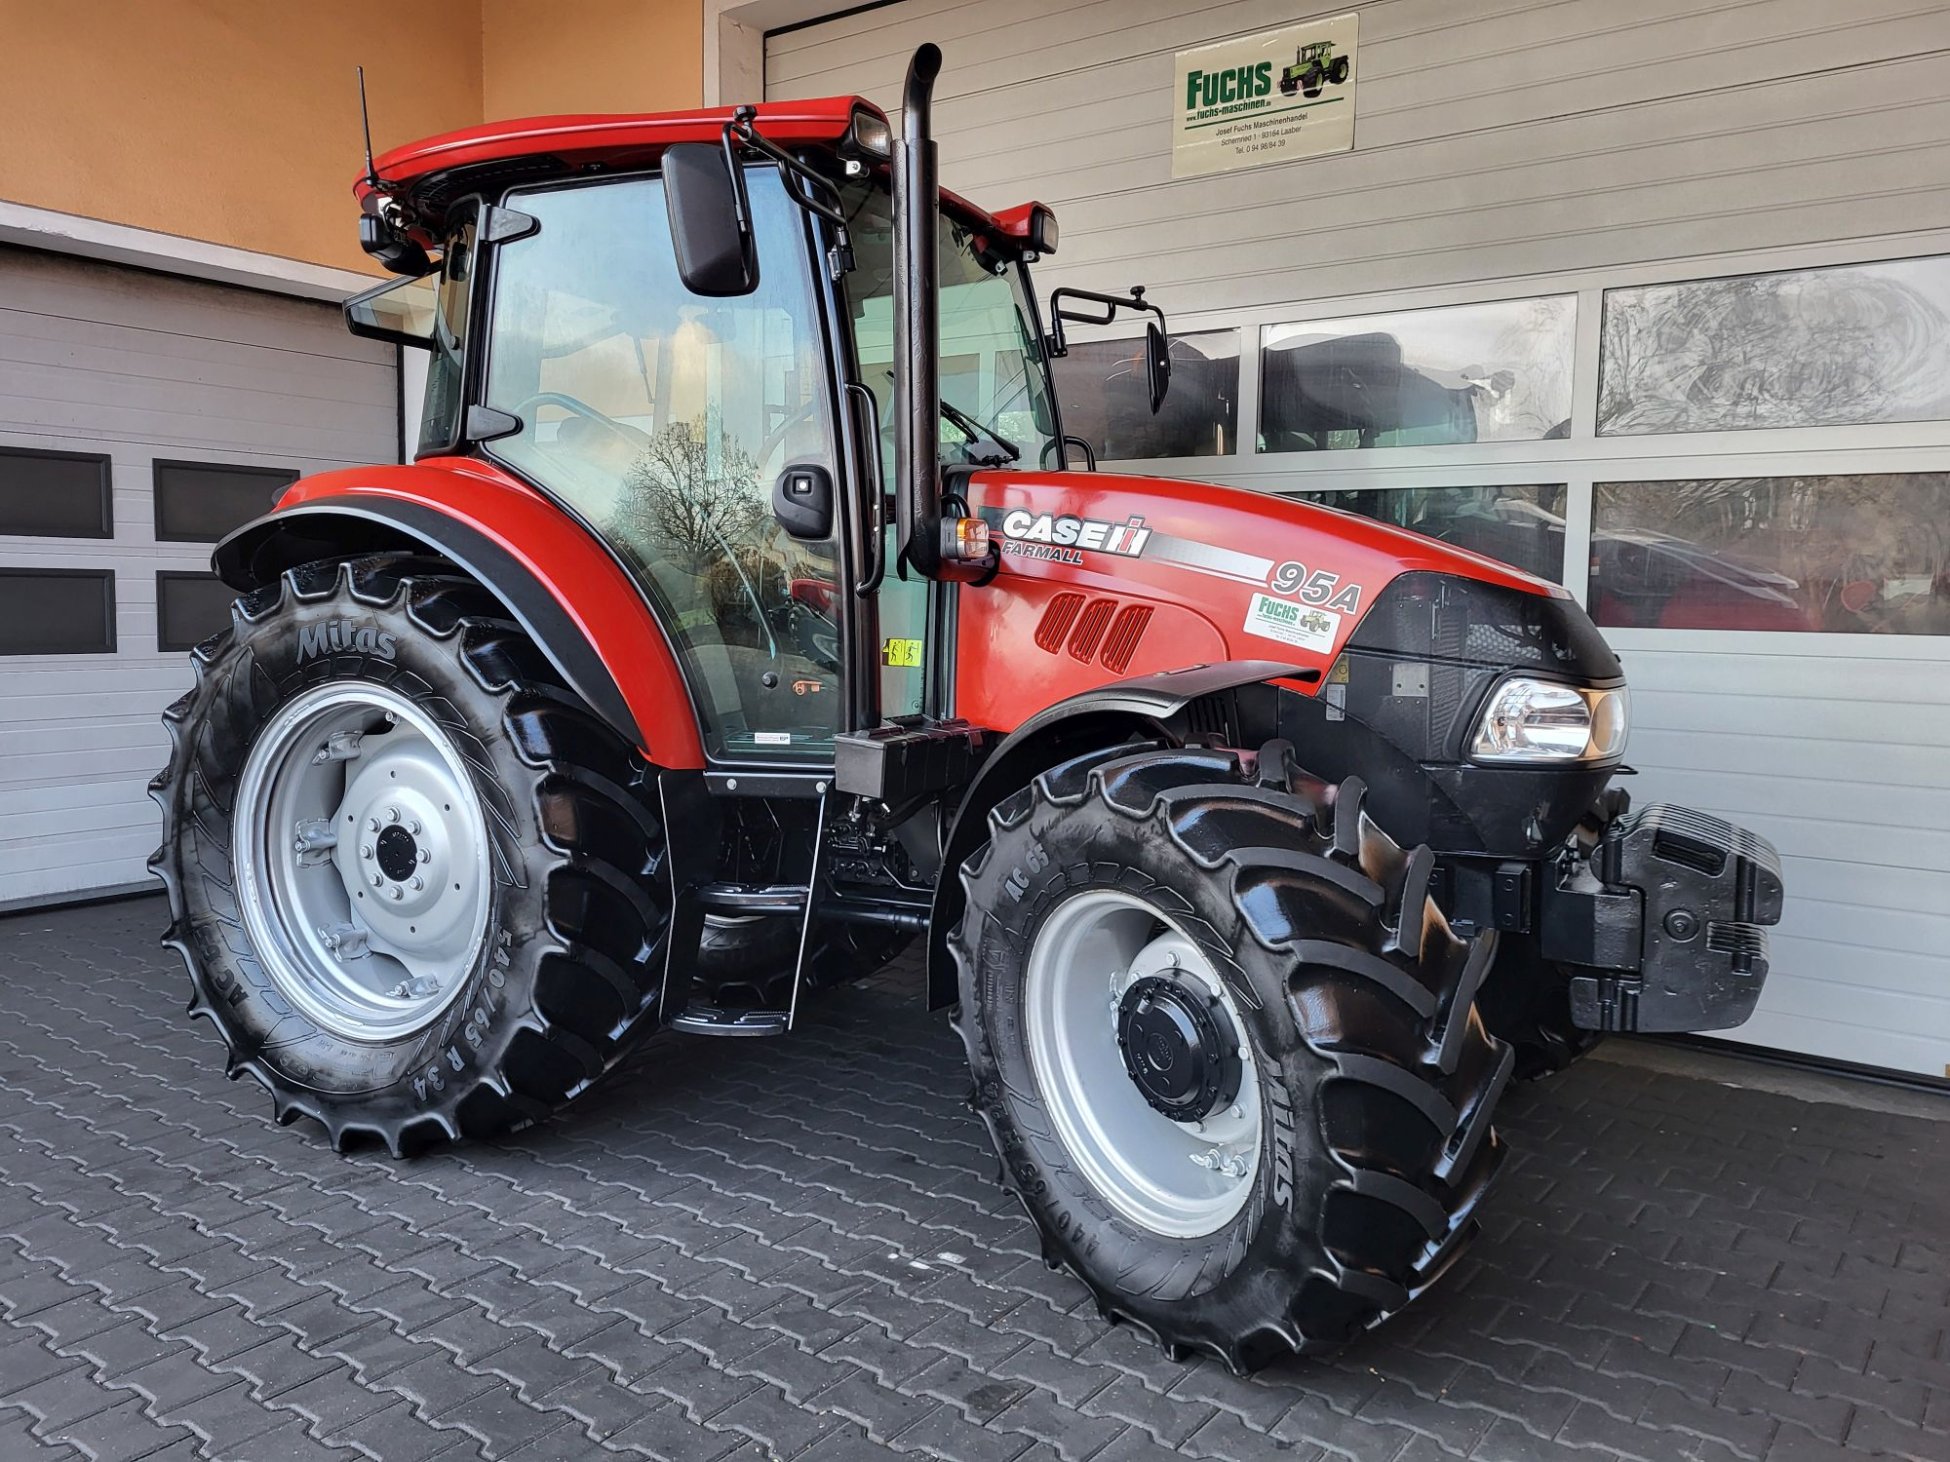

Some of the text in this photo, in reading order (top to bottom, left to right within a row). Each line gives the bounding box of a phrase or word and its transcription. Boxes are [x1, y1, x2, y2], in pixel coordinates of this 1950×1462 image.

[1186, 61, 1272, 110] FUCHS
[1216, 112, 1308, 136] Josef Fuchs Maschinenhandel
[1280, 126, 1302, 136] Laaber
[1235, 146, 1245, 154] Tel.
[1246, 145, 1251, 153] 0
[1251, 144, 1259, 152] 94
[1277, 139, 1286, 147] 39
[1002, 510, 1110, 549] CASE
[1001, 540, 1084, 565] FARMALL
[1271, 561, 1362, 615] 95A
[1258, 596, 1300, 622] FUCHS
[296, 618, 398, 665] Mitas
[1004, 842, 1050, 903] AC 65
[413, 926, 513, 1101] 540/65 R 34
